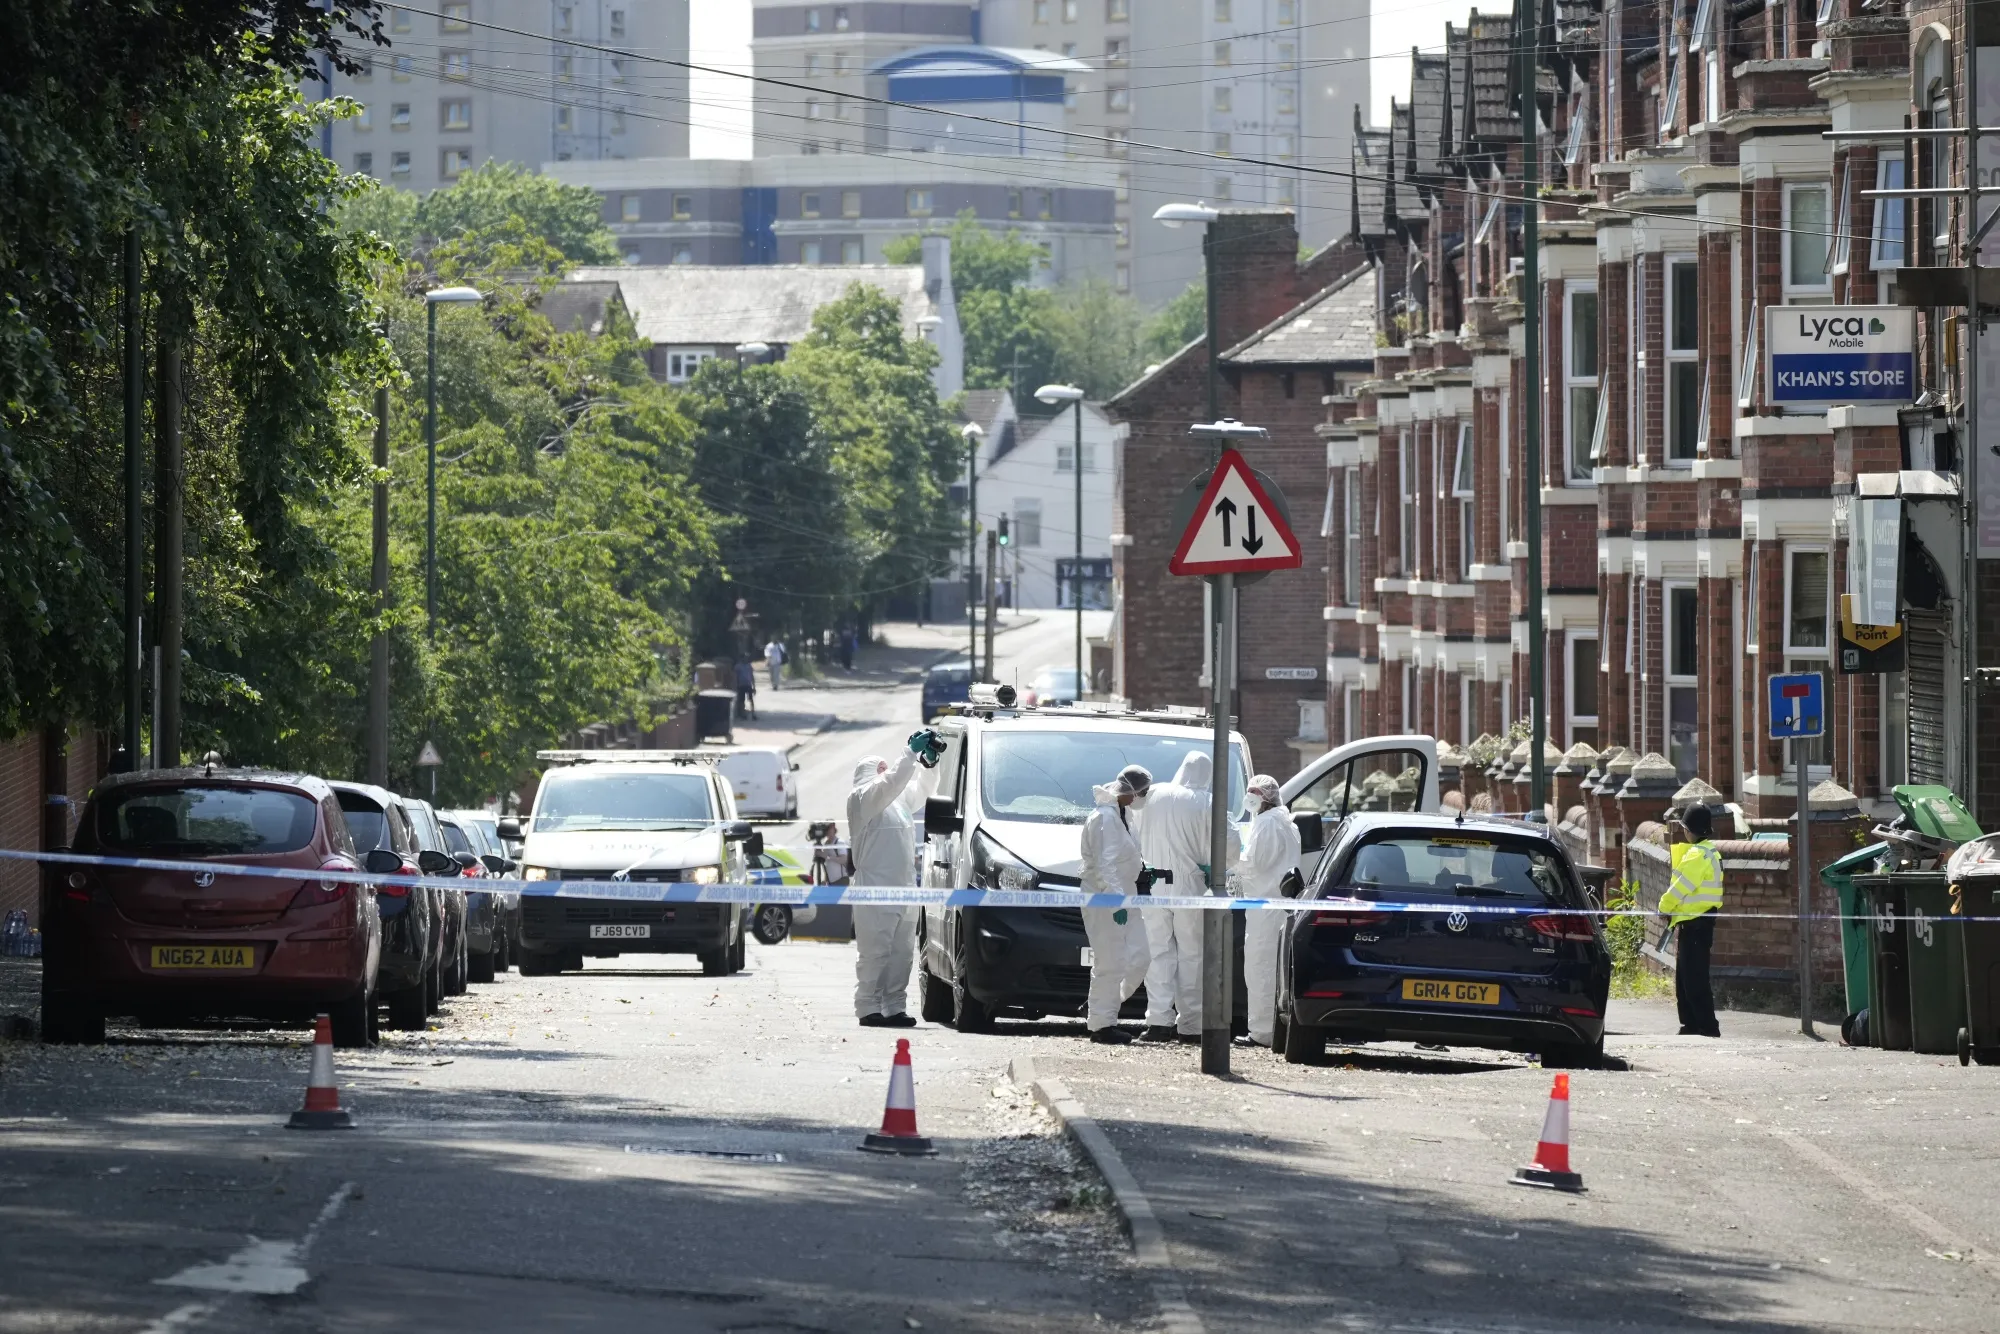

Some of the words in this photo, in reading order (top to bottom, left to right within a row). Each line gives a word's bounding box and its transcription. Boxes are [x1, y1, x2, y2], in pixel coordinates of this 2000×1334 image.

[1800, 315, 1864, 341] Lyca
[1829, 339, 1864, 348] Mobile
[1777, 371, 1845, 387] KHAN'S
[1849, 370, 1905, 386] STORE
[1856, 630, 1888, 640] Point
[595, 926, 622, 936] FJ69
[625, 926, 646, 936] CVD
[159, 948, 205, 965] NG62
[1413, 982, 1451, 999] GR14
[1456, 984, 1489, 1001] GGY
